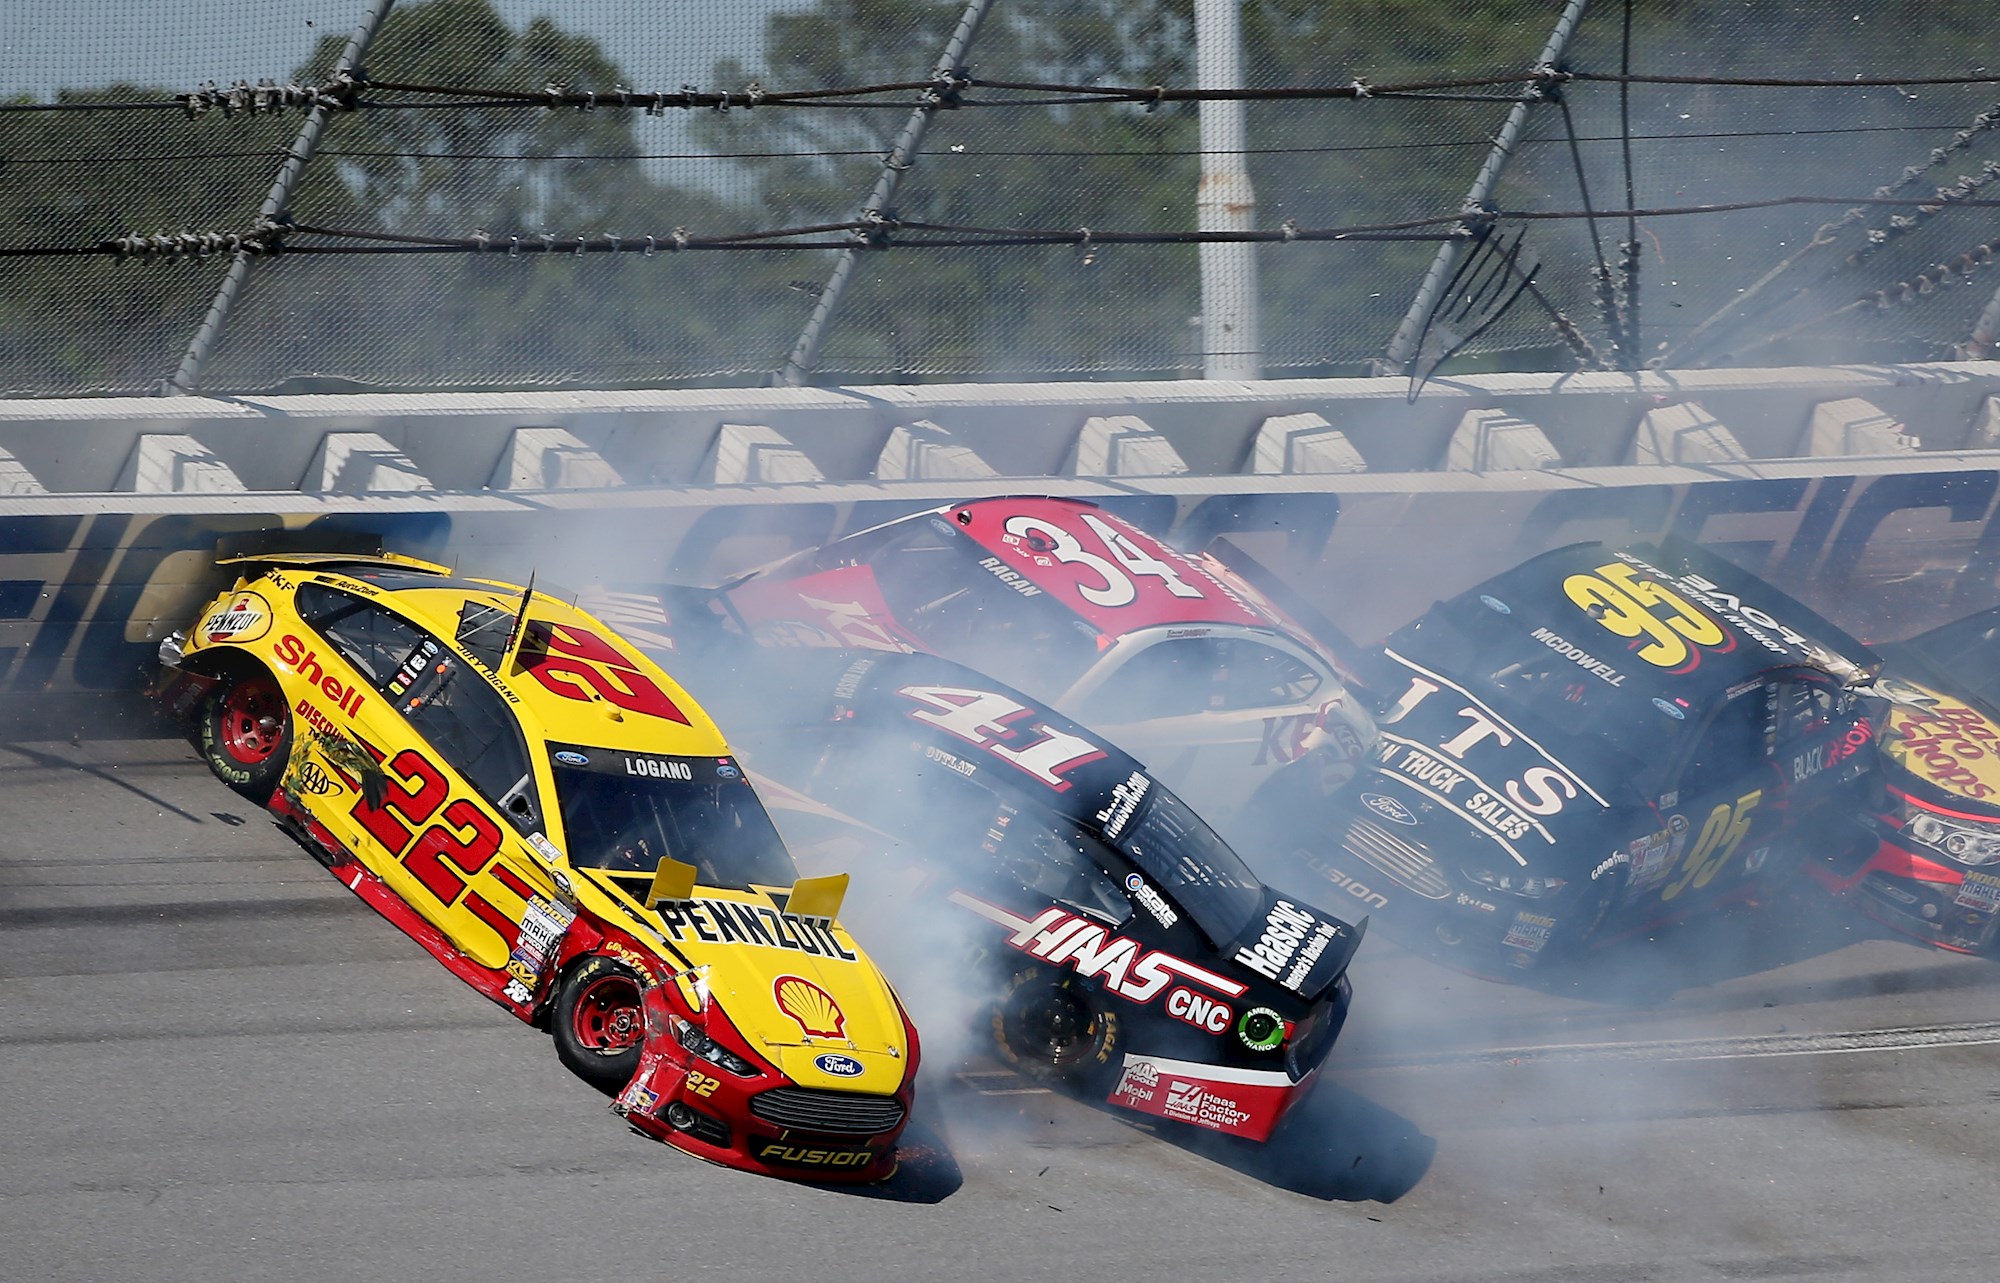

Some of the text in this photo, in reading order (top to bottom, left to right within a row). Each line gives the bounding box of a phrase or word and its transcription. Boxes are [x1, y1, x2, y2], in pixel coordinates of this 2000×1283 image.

[978, 556, 1043, 597] RAGAN
[1001, 514, 1203, 608] 34
[1562, 562, 1726, 668] 95
[1613, 551, 1788, 656] JORDAN TRUCK SALES
[273, 634, 367, 720] Shell
[456, 645, 483, 672] JOEY
[480, 667, 521, 704] LOGANO
[1530, 627, 1627, 688] MCDOWELL
[899, 685, 1103, 788] 41
[1905, 713, 1985, 760] Pro
[623, 757, 693, 781] LOGANO
[924, 745, 977, 777] OUTLAW
[1898, 721, 1997, 799] Shops
[1369, 796, 1409, 821] Ford
[1399, 750, 1466, 794] TRUCK
[1466, 792, 1530, 841] SALES
[350, 748, 504, 908] 22
[1661, 789, 1762, 901] 95
[1301, 851, 1389, 909] FUSION
[528, 893, 571, 929] MOOG
[1137, 884, 1179, 925] state
[658, 900, 859, 963] PENNZOIL
[1234, 898, 1316, 981] HaasCNC
[605, 941, 658, 987] GOODYEAR
[1279, 952, 1314, 993] America's
[1300, 930, 1329, 962] Machine
[1168, 988, 1231, 1033] CNC
[1247, 1006, 1285, 1030] AMERICAN
[1096, 1011, 1117, 1064] EAGLE
[1239, 1031, 1277, 1052] ETHANOL
[686, 1070, 720, 1098] 22
[1123, 1082, 1154, 1101] Mobil
[1127, 1073, 1159, 1088] TOOLS
[1129, 1062, 1159, 1081] MAC
[1168, 1109, 1192, 1121] Division
[1199, 1109, 1239, 1127] Outlet
[1201, 1102, 1250, 1122] Factory
[1202, 1092, 1237, 1108] Haas
[759, 1144, 873, 1166] FUSION
